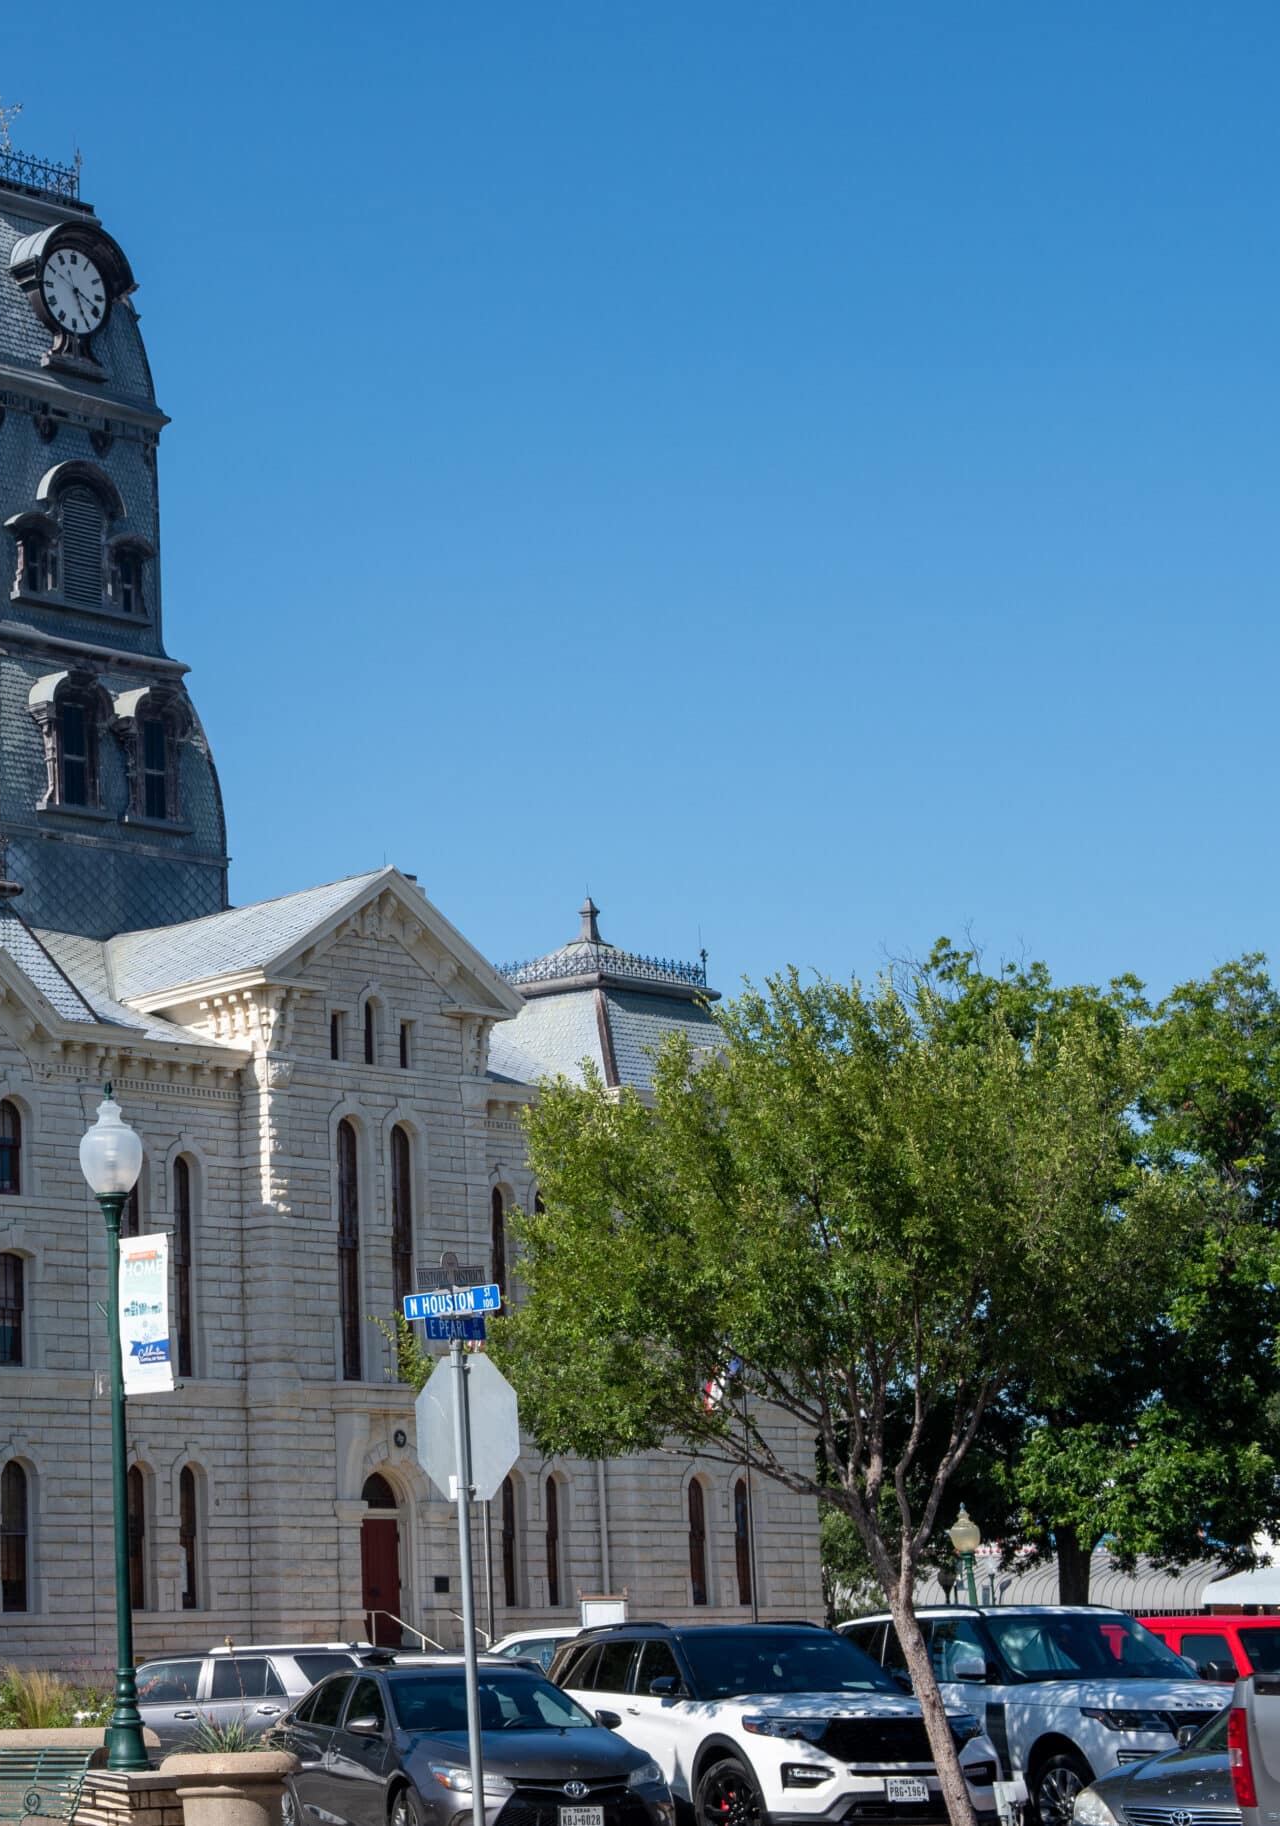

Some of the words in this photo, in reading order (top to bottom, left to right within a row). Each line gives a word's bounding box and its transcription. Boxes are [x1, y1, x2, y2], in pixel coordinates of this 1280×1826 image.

[125, 1258, 162, 1280] HOME
[409, 1298, 418, 1316] N
[422, 1291, 475, 1315] HOUSTON
[484, 1287, 491, 1297] ST
[483, 1298, 494, 1308] 100
[430, 1320, 437, 1337] E
[440, 1319, 469, 1338] PEARL
